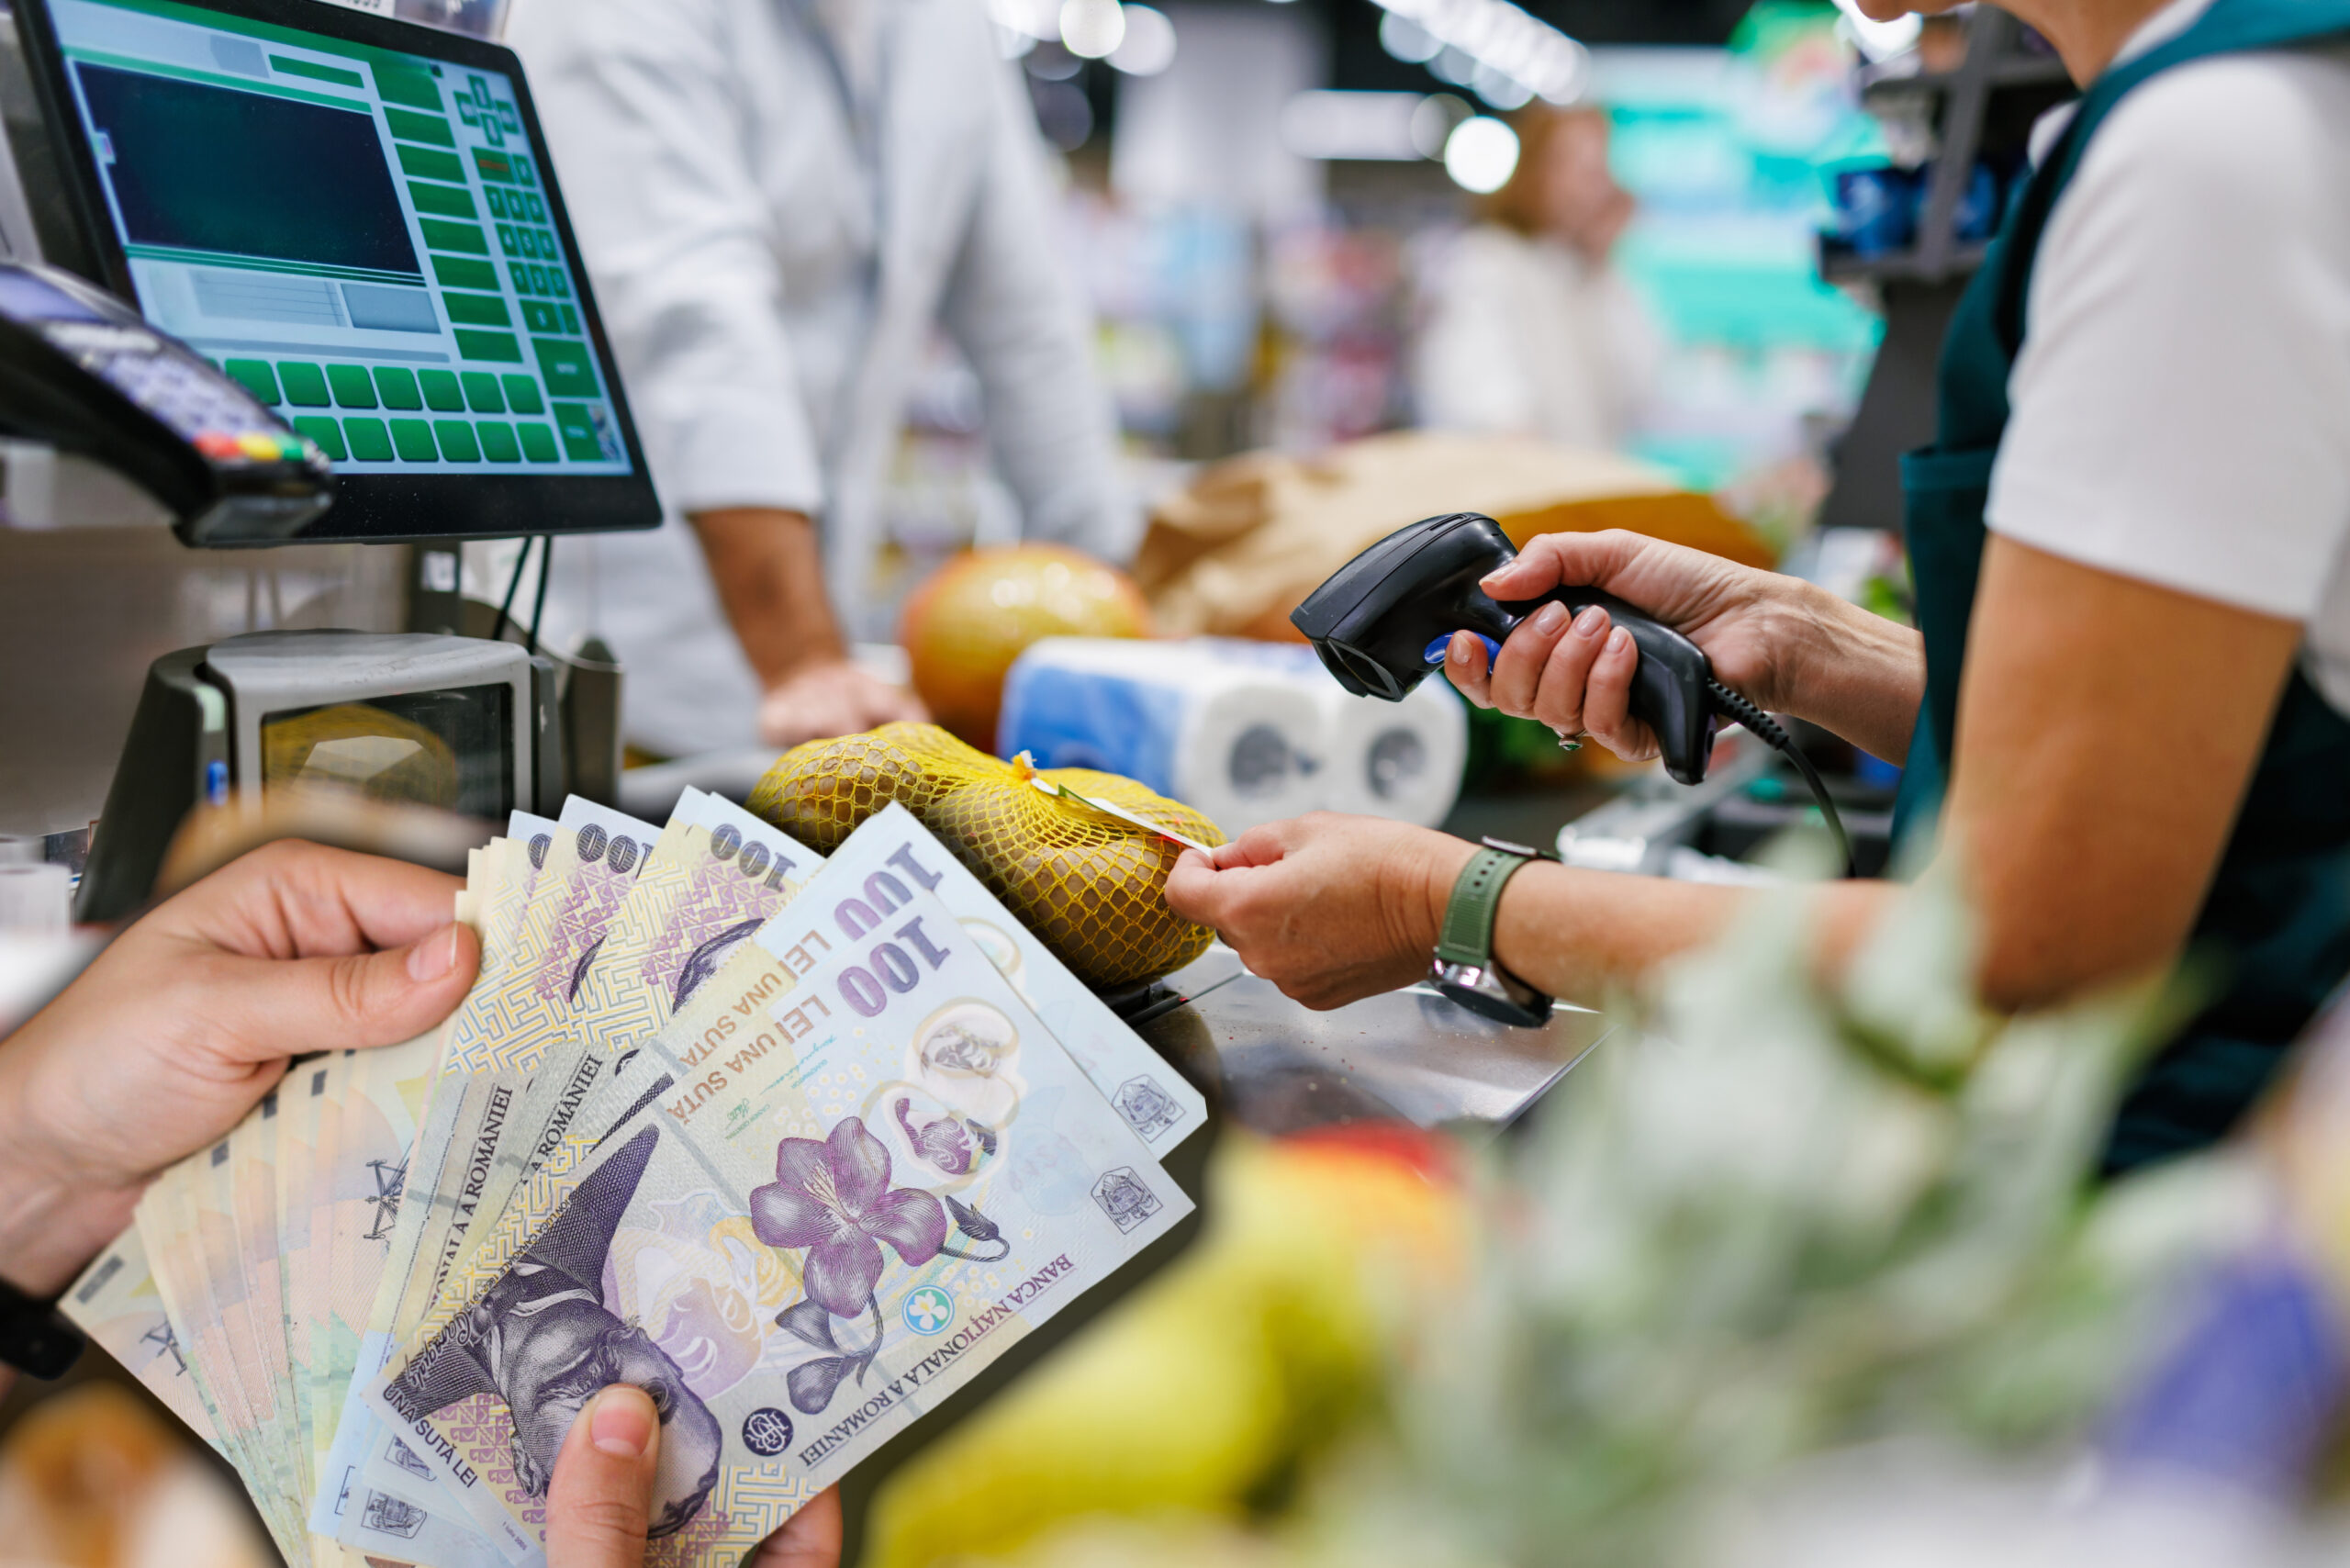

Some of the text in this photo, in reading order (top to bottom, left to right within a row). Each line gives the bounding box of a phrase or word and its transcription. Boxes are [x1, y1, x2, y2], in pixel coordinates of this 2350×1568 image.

[711, 823, 797, 892] 100
[778, 929, 832, 980] LEI
[837, 915, 951, 1017] 100
[732, 972, 782, 1016] UNA
[775, 994, 832, 1044] LEI
[724, 1034, 777, 1073] UNA
[464, 1086, 513, 1203] ROMÂNIEI
[461, 1202, 477, 1217] A
[534, 1212, 558, 1236] LUCA
[495, 1231, 540, 1276] CARAGIALE
[1008, 1254, 1074, 1305] BANCA
[889, 1381, 905, 1396] A
[383, 1384, 416, 1424] UNA
[415, 1419, 458, 1464] SUTĂ
[453, 1460, 478, 1488] LEI
